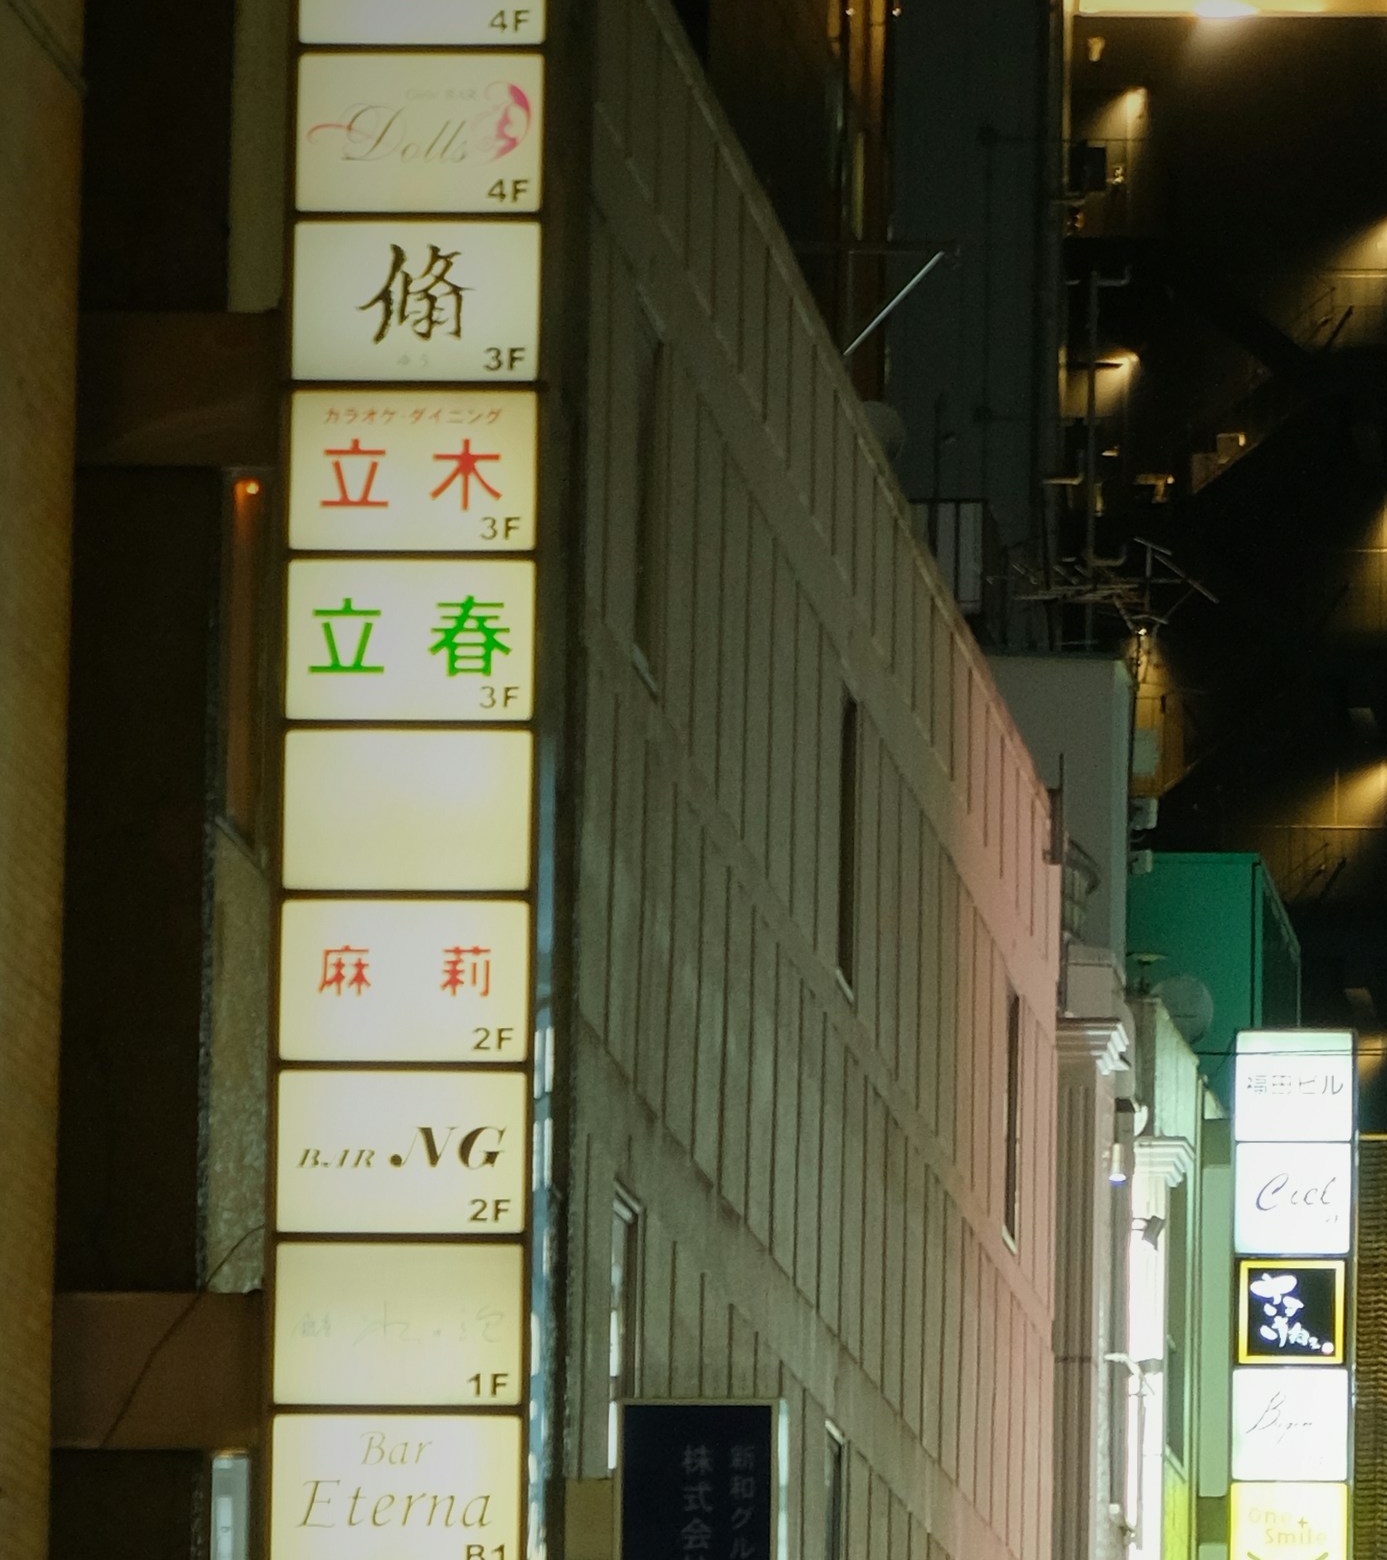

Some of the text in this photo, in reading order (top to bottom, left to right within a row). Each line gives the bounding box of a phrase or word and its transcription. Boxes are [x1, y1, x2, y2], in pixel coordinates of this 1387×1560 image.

[489, 9, 531, 34] 4F
[487, 178, 529, 203] 4F
[483, 346, 526, 373] 3F
[320, 437, 502, 511] 立木
[480, 516, 521, 541] 3F
[308, 594, 512, 678] 立春
[479, 685, 520, 710] 3F
[316, 943, 493, 999] 麻莉
[472, 1026, 514, 1050] 2F
[297, 1145, 375, 1169] BAR
[468, 1198, 510, 1221] 2F
[467, 1372, 508, 1397] 1F
[359, 1429, 433, 1467] Bar
[294, 1478, 494, 1530] Eterna
[1247, 1506, 1292, 1524] one
[1263, 1527, 1328, 1545] Smile
